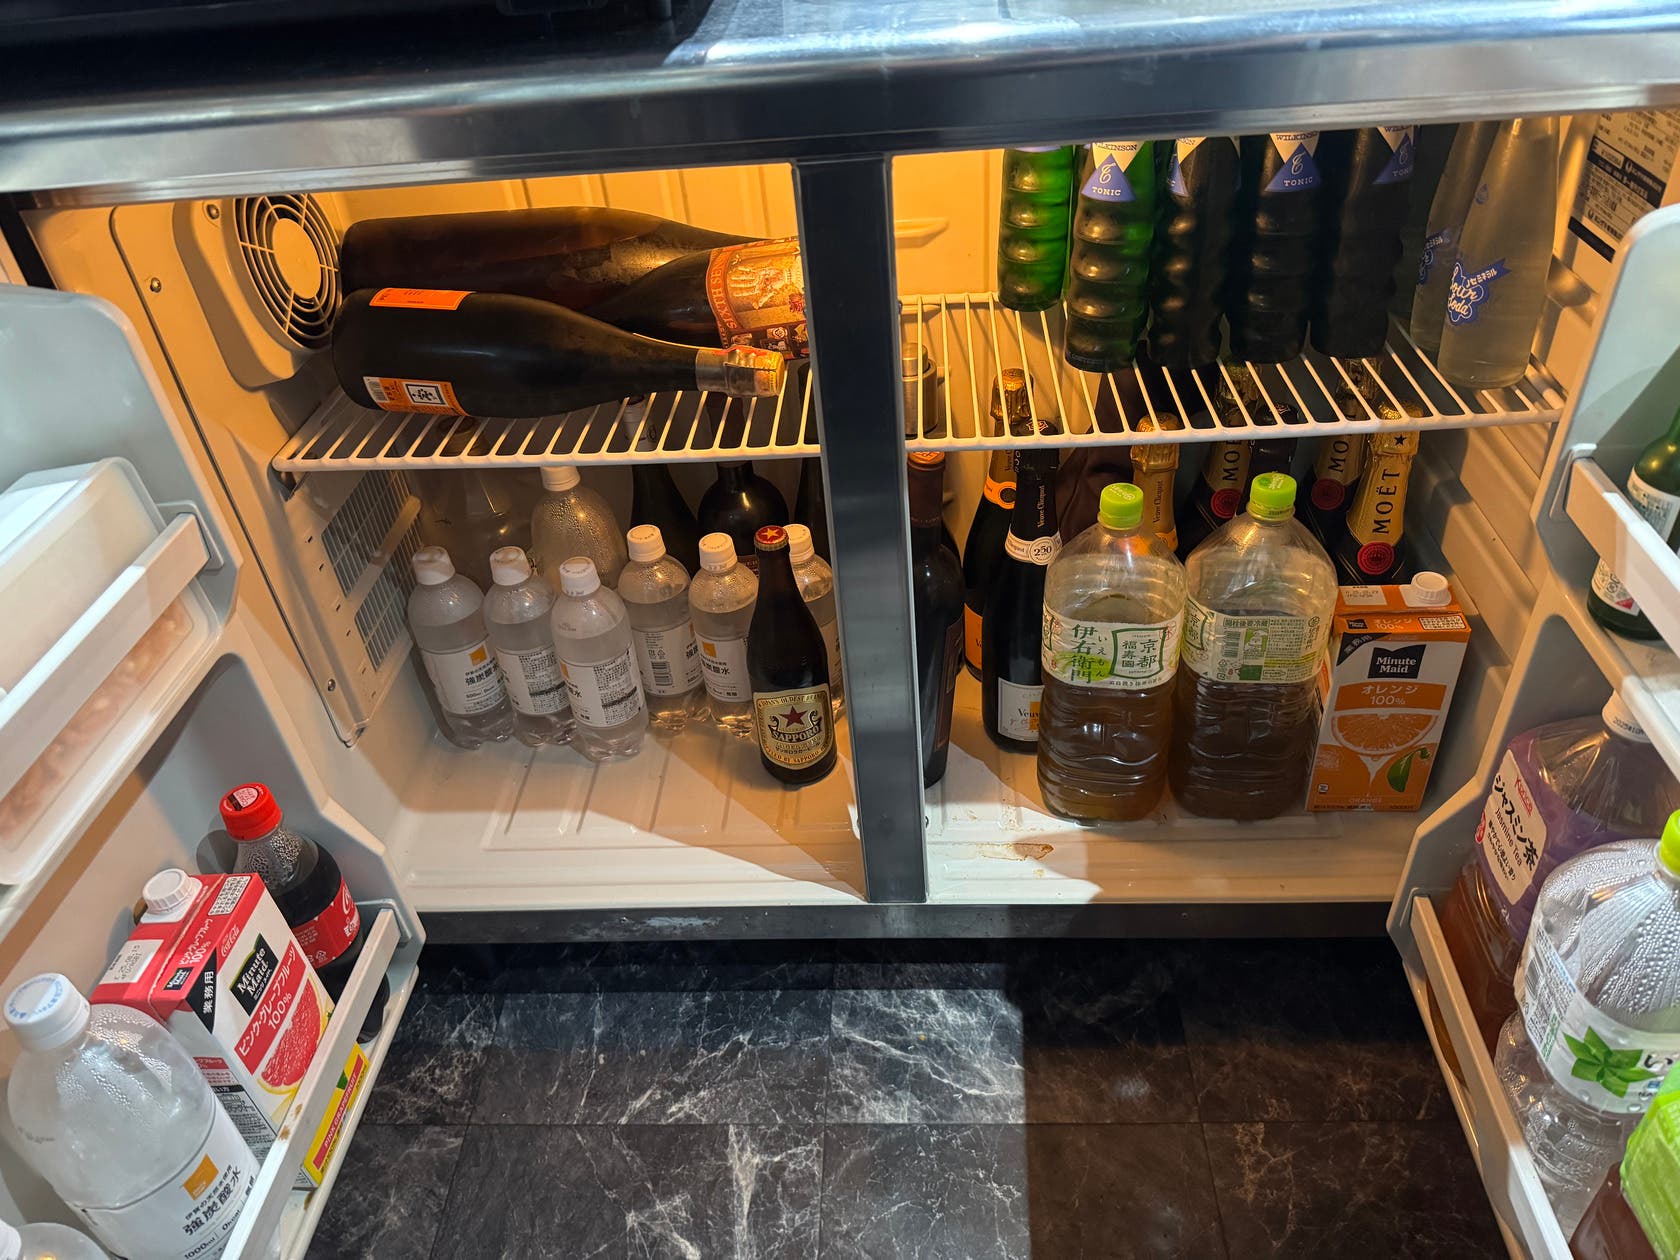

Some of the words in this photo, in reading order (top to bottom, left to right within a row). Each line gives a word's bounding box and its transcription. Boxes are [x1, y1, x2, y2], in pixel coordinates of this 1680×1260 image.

[1091, 186, 1121, 196] TONIC
[1283, 176, 1313, 187] TONIC
[712, 289, 738, 330] SIXTH
[1372, 468, 1400, 535] MOËT
[1376, 623, 1404, 631] 100%
[1070, 623, 1098, 684] 伊右衛門
[1096, 634, 1109, 678] いえもん
[1136, 638, 1159, 669] 京都
[1376, 657, 1416, 665] Minute
[1379, 665, 1409, 674] Maid
[1361, 685, 1418, 694] オレンジ
[1371, 695, 1406, 705] 100%
[1018, 708, 1041, 720] Veuv
[772, 725, 820, 743] SAPPORO
[1493, 774, 1539, 871] ジャスミン茶
[1494, 808, 1514, 848] Jasmine
[1511, 846, 1523, 867] Tea
[188, 941, 212, 964] 100%
[237, 947, 266, 993] Minute
[203, 970, 215, 1014] 業務用
[247, 960, 269, 996] Maid
[239, 946, 296, 1057] ピンク・グレープフルーツ
[268, 992, 292, 1030] 100%
[323, 1128, 338, 1150] PINK
[332, 1074, 357, 1131] GRAPEFRUIT
[182, 1166, 241, 1236] 強炭酸水
